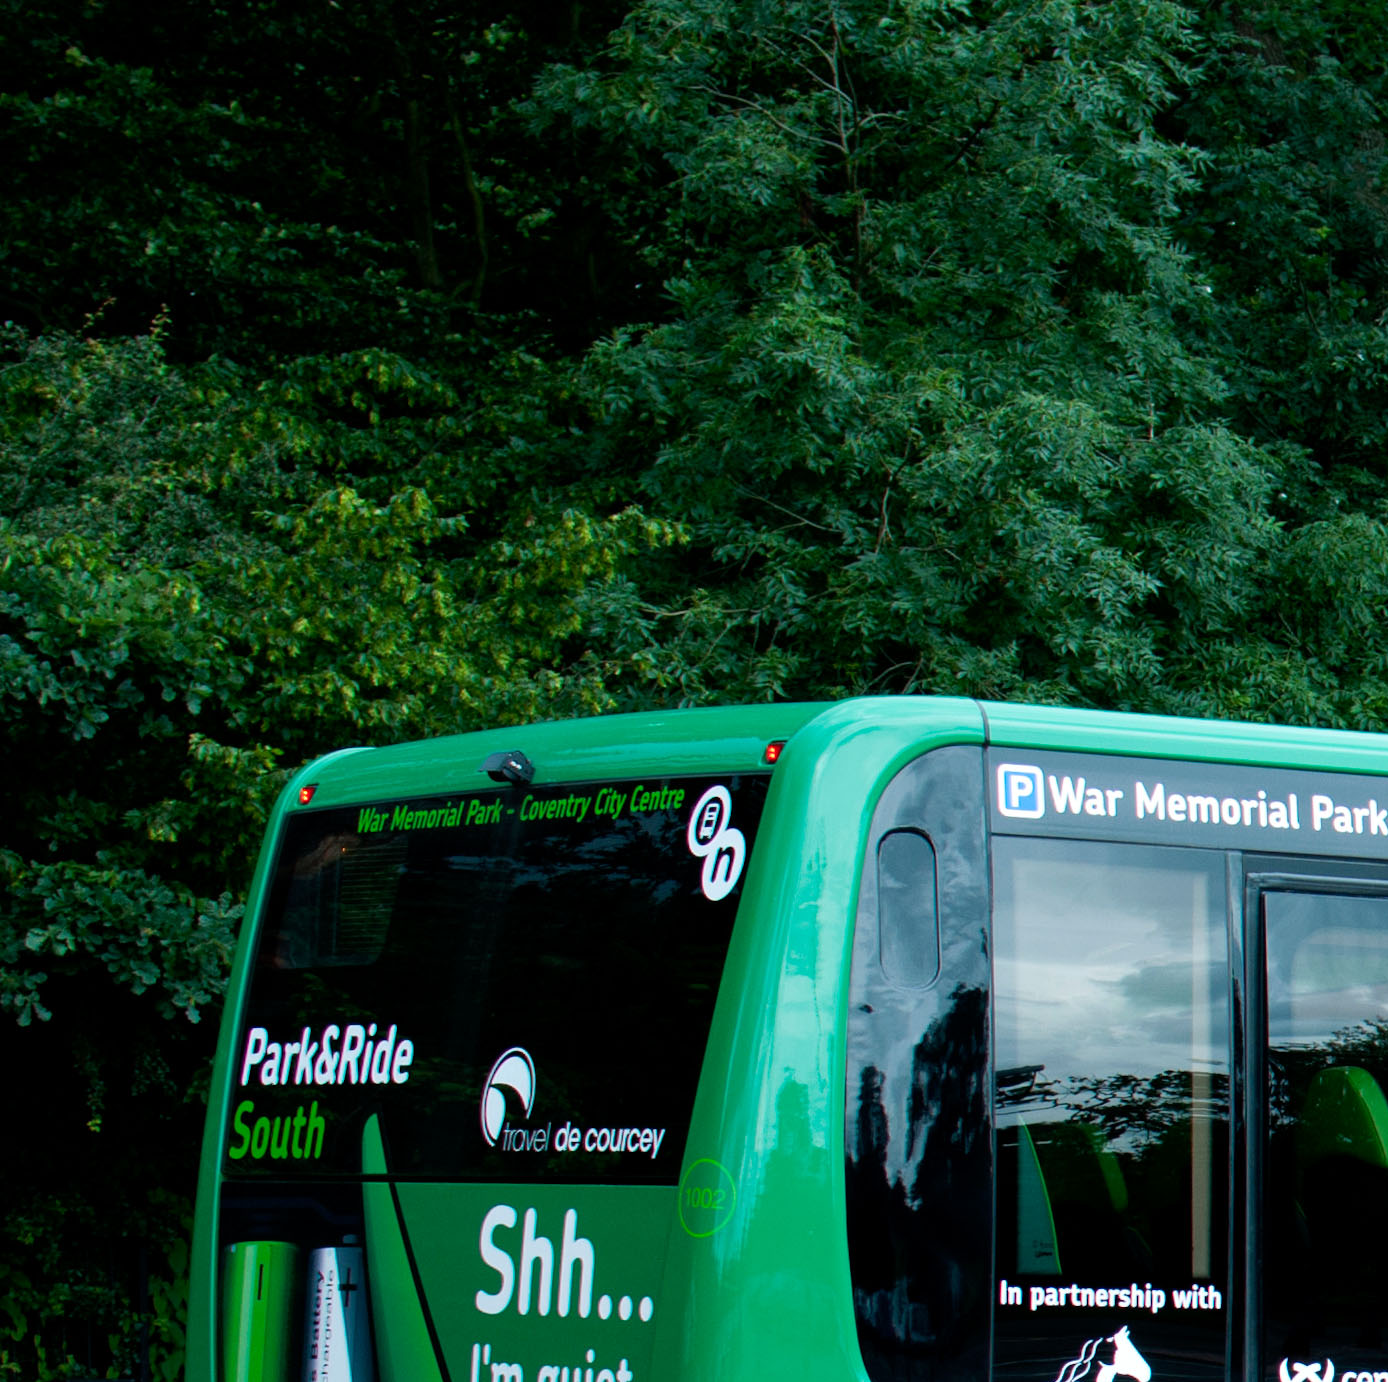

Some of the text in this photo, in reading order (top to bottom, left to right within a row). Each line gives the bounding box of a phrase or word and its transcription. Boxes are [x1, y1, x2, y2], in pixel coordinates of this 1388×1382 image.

[358, 808, 387, 833] War
[391, 802, 464, 831] Memorial
[466, 798, 503, 825] Park
[520, 795, 591, 822] Coventry
[594, 788, 626, 819] City
[630, 785, 685, 811] Centre
[1049, 776, 1123, 817] War
[1135, 781, 1300, 831] Memorial
[240, 1024, 414, 1087] Park&Ride
[229, 1101, 326, 1160] South
[503, 1121, 665, 1159] travel de courcey
[686, 1187, 725, 1209] 1002
[475, 1204, 654, 1322] Shh...
[311, 1271, 324, 1359] Battery
[1000, 1280, 1222, 1314] In partnership with
